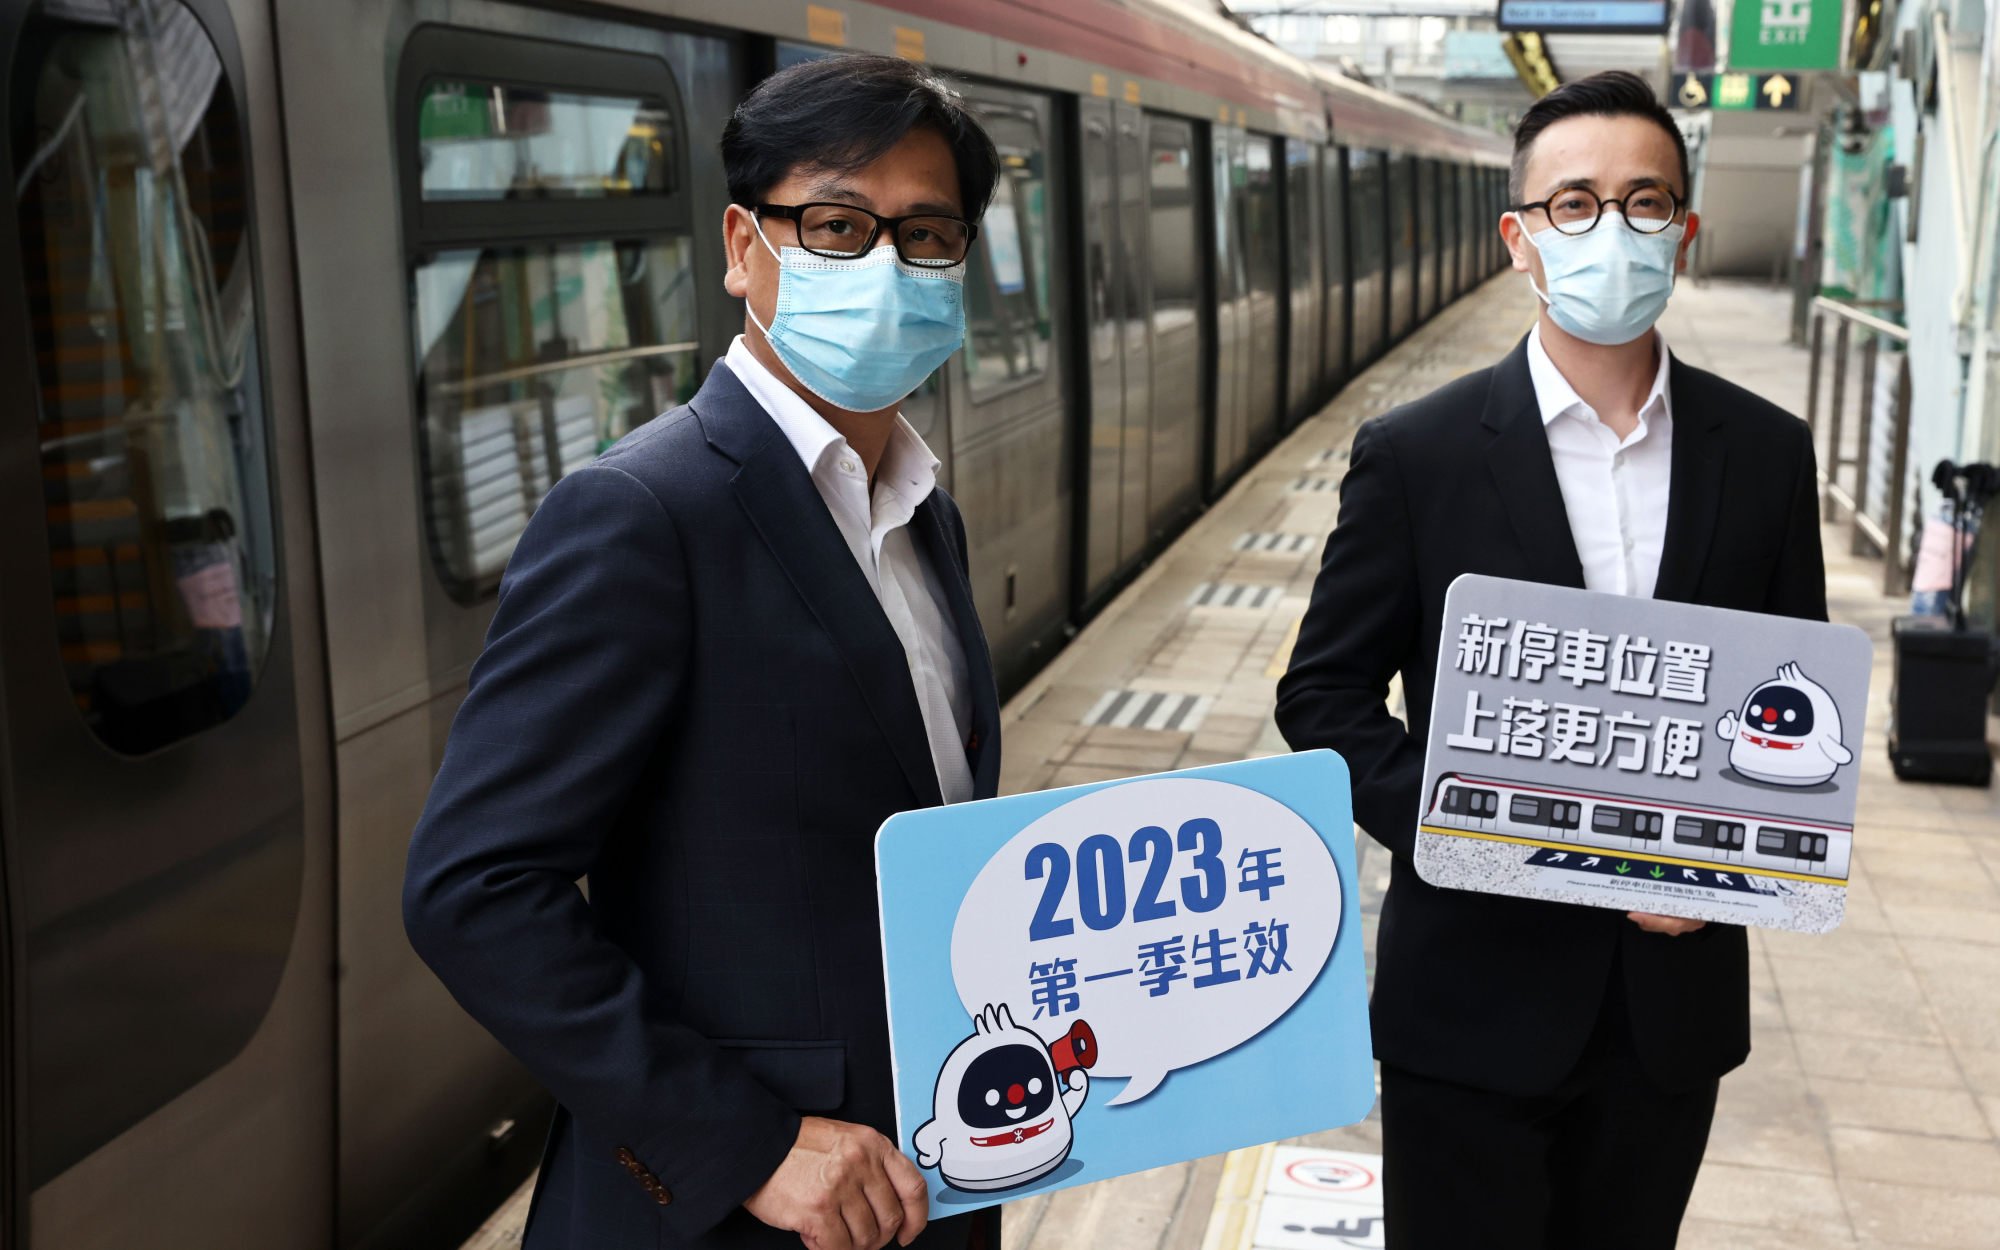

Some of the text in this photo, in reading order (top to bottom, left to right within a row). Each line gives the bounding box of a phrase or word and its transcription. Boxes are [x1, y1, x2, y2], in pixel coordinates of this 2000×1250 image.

[1759, 30, 1807, 45] EXIT
[1455, 613, 1711, 703] 新停車位置
[1446, 690, 1703, 778] 上落更方便
[1029, 918, 1293, 1020] 第一季生效
